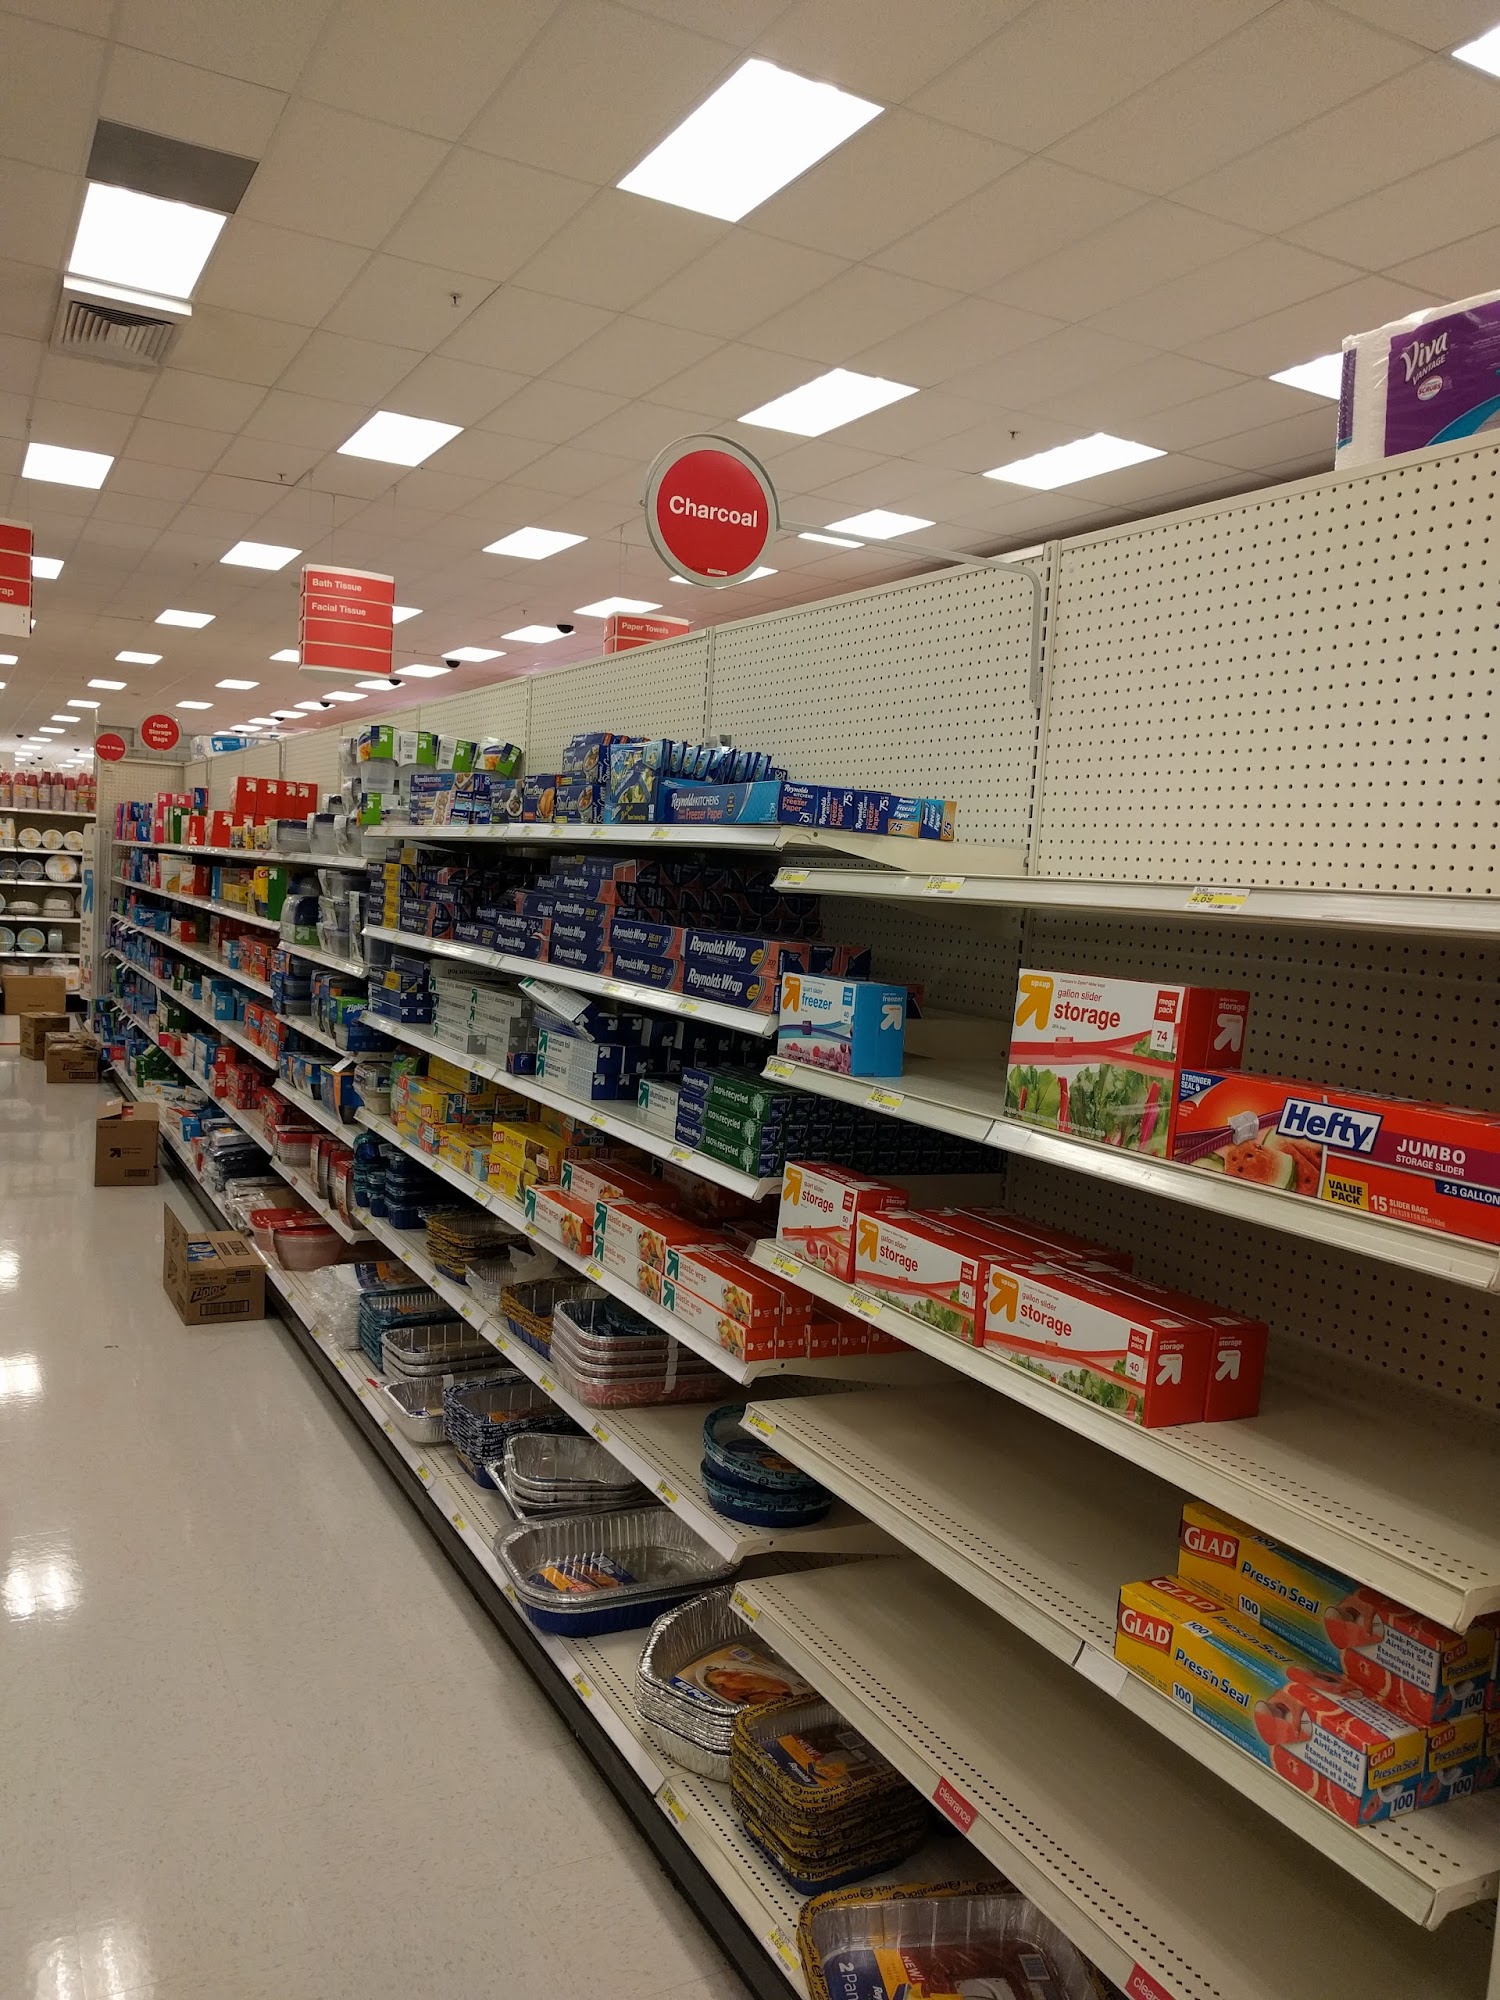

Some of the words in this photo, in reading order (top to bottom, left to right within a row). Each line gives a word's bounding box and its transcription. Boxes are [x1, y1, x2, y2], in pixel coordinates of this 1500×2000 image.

[1400, 332, 1448, 382] Viva
[1412, 354, 1446, 386] VANTAGE
[669, 495, 758, 528] Charcoal
[312, 578, 333, 588] Bath
[335, 580, 362, 592] Tissue
[311, 602, 337, 612] Facial
[339, 604, 366, 616] Tissue
[621, 621, 644, 632] Paper
[645, 623, 669, 634] Towels
[148, 728, 172, 736] Storage
[784, 783, 809, 794] Reynolds
[782, 796, 808, 807] Freezer
[782, 803, 802, 812] Paper
[843, 794, 853, 807] 75
[879, 798, 889, 812] 75
[896, 805, 916, 813] Freezer
[685, 808, 706, 820] Freezer
[707, 807, 723, 822] Paper
[799, 811, 810, 823] 75
[830, 797, 838, 826] Freezer
[836, 803, 844, 826] Paper
[866, 801, 875, 831] Freezer
[872, 809, 880, 831] Paper
[893, 811, 910, 819] Paper
[889, 821, 902, 832] 75
[553, 922, 574, 936] Reynolds
[573, 926, 587, 941] Wrap
[612, 924, 635, 940] Reynolds
[633, 929, 647, 943] Wrap
[554, 944, 575, 959] Reynolds
[573, 948, 588, 964] Wrap
[689, 935, 725, 957] Reynolds
[724, 940, 747, 962] Wrap
[615, 955, 638, 970] Reynolds
[636, 959, 650, 974] Wrap
[687, 967, 722, 988] Reynolds
[721, 974, 743, 996] Wrap
[801, 992, 833, 1011] freezer
[882, 995, 904, 1003] freezer
[1057, 989, 1080, 999] gallon
[1080, 990, 1102, 1001] slider
[1158, 998, 1176, 1007] mega
[346, 1003, 368, 1013] Ziploc
[1053, 1001, 1121, 1031] storage
[1158, 1006, 1174, 1014] pack
[1218, 1001, 1246, 1012] storage
[1156, 1030, 1168, 1041] 74
[1180, 1081, 1196, 1090] SEAL
[1181, 1073, 1212, 1086] STRONGER
[713, 1085, 726, 1096] 100%
[725, 1089, 749, 1104] recycled
[708, 1109, 720, 1121] 100%
[719, 1115, 741, 1130] recycled
[1284, 1103, 1375, 1149] Hefty
[705, 1136, 718, 1147] 100%
[717, 1141, 739, 1157] recycled
[1396, 1138, 1466, 1165] JUMBO
[1395, 1154, 1434, 1170] STORAGE
[1435, 1163, 1465, 1177] SLIDER
[1328, 1179, 1363, 1197] VALUE
[1331, 1190, 1361, 1205] PACK
[1443, 1184, 1458, 1195] 2.5
[1459, 1187, 1500, 1205] GALLON
[801, 1190, 834, 1213] storage
[886, 1198, 907, 1206] storage
[1370, 1194, 1388, 1212] 15
[1389, 1199, 1411, 1211] SLIDER
[1411, 1204, 1429, 1215] BAGS
[608, 1214, 621, 1226] plastic
[621, 1224, 633, 1234] wrap
[842, 1215, 849, 1223] 50
[880, 1235, 894, 1246] gallon
[894, 1240, 907, 1250] slider
[880, 1245, 919, 1272] storage
[680, 1261, 695, 1276] plastic
[695, 1270, 707, 1283] wrap
[676, 1292, 690, 1307] plastic
[690, 1302, 702, 1315] wrap
[961, 1290, 970, 1299] 40
[1021, 1292, 1039, 1304] gallon
[1040, 1299, 1057, 1311] slider
[1020, 1304, 1072, 1336] storage
[1159, 1343, 1184, 1351] storage
[1219, 1339, 1242, 1347] storage
[1129, 1361, 1139, 1372] 40
[1184, 1526, 1236, 1559] GLAD
[1151, 1579, 1216, 1611] GLAD
[1241, 1560, 1288, 1597] Press'n
[1288, 1585, 1319, 1614] Seal
[1239, 1596, 1259, 1616] 100
[1120, 1608, 1170, 1645] GLAD
[1189, 1621, 1209, 1634] 100
[1386, 1629, 1427, 1656] Leak-Proof
[1428, 1652, 1434, 1660] &
[1386, 1638, 1415, 1659] Airtight
[1416, 1655, 1433, 1668] Seal
[1443, 1644, 1467, 1664] GLAD
[1376, 1653, 1401, 1672] liquides
[1175, 1647, 1219, 1689] Press'n
[1219, 1678, 1250, 1708] Seal
[1417, 1667, 1431, 1680] aux
[1174, 1684, 1191, 1705] 100
[1464, 1690, 1483, 1709] 100
[1314, 1727, 1354, 1758] Leak-Proof
[1354, 1754, 1360, 1762] &
[1431, 1729, 1454, 1749] GLAD
[798, 1738, 821, 1761] NEW!
[1313, 1737, 1342, 1759] Airtight
[1343, 1756, 1360, 1771] Seal
[1370, 1745, 1394, 1767] GLAD
[1304, 1752, 1329, 1773] liquides
[1403, 1755, 1420, 1770] Seal
[787, 1761, 812, 1784] Reynolds
[1343, 1769, 1358, 1782] aux
[1452, 1777, 1471, 1795] 100
[938, 1786, 971, 1824] clearance
[1393, 1794, 1413, 1811] 100
[838, 1962, 855, 1972] 2
[902, 1955, 925, 1982] NEW!
